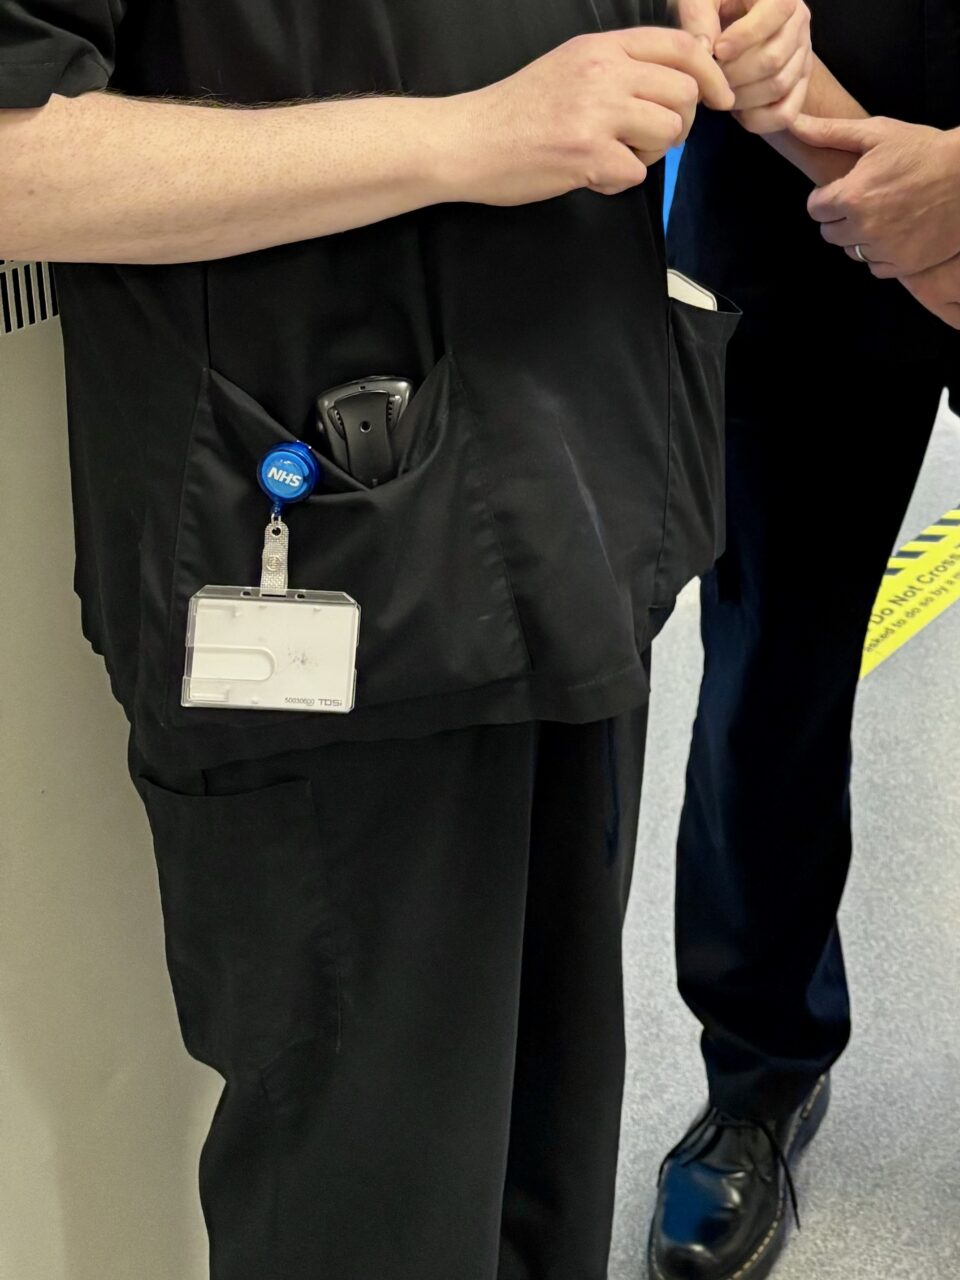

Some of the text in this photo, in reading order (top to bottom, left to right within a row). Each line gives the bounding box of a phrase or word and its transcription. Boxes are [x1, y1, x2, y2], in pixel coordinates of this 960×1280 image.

[267, 466, 304, 488] NHS
[887, 585, 924, 607] Not
[905, 607, 921, 619] do
[929, 585, 949, 597] by
